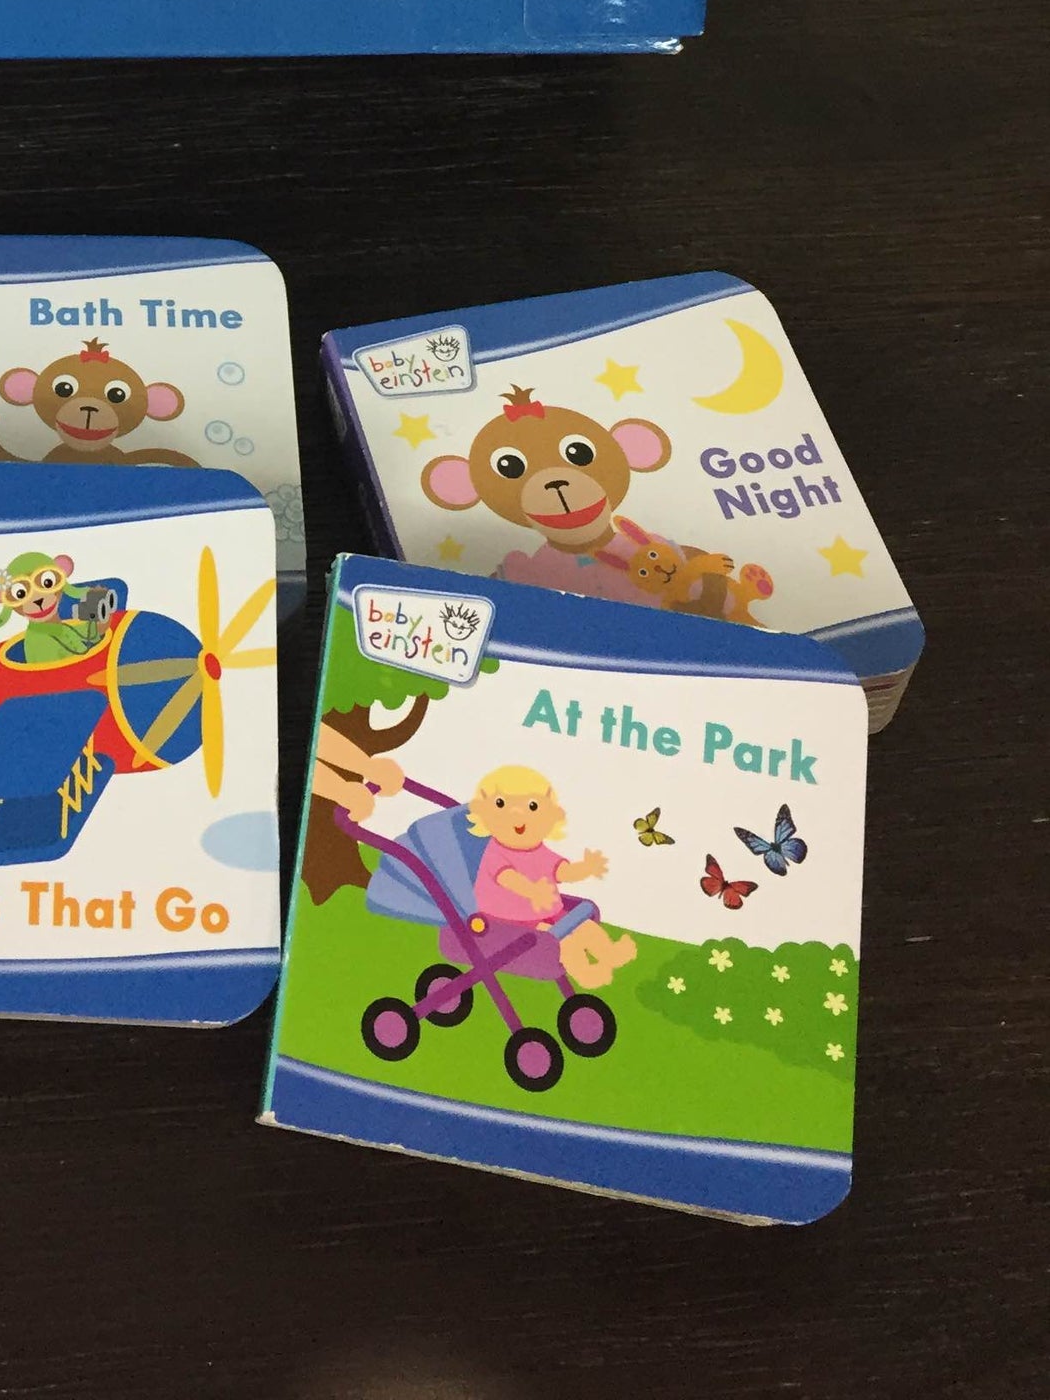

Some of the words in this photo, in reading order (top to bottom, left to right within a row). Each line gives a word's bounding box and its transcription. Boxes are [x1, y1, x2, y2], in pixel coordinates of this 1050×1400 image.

[29, 297, 124, 328] Bath
[140, 299, 244, 330] Time
[368, 351, 416, 377] baby
[379, 356, 464, 390] einstein
[699, 433, 823, 479] Good
[712, 474, 842, 521] Night
[368, 598, 424, 632] baby
[368, 628, 469, 667] einstein
[521, 688, 581, 738] At
[600, 706, 682, 758] the
[702, 720, 819, 785] Park
[20, 880, 136, 930] That
[155, 887, 231, 934] Go
